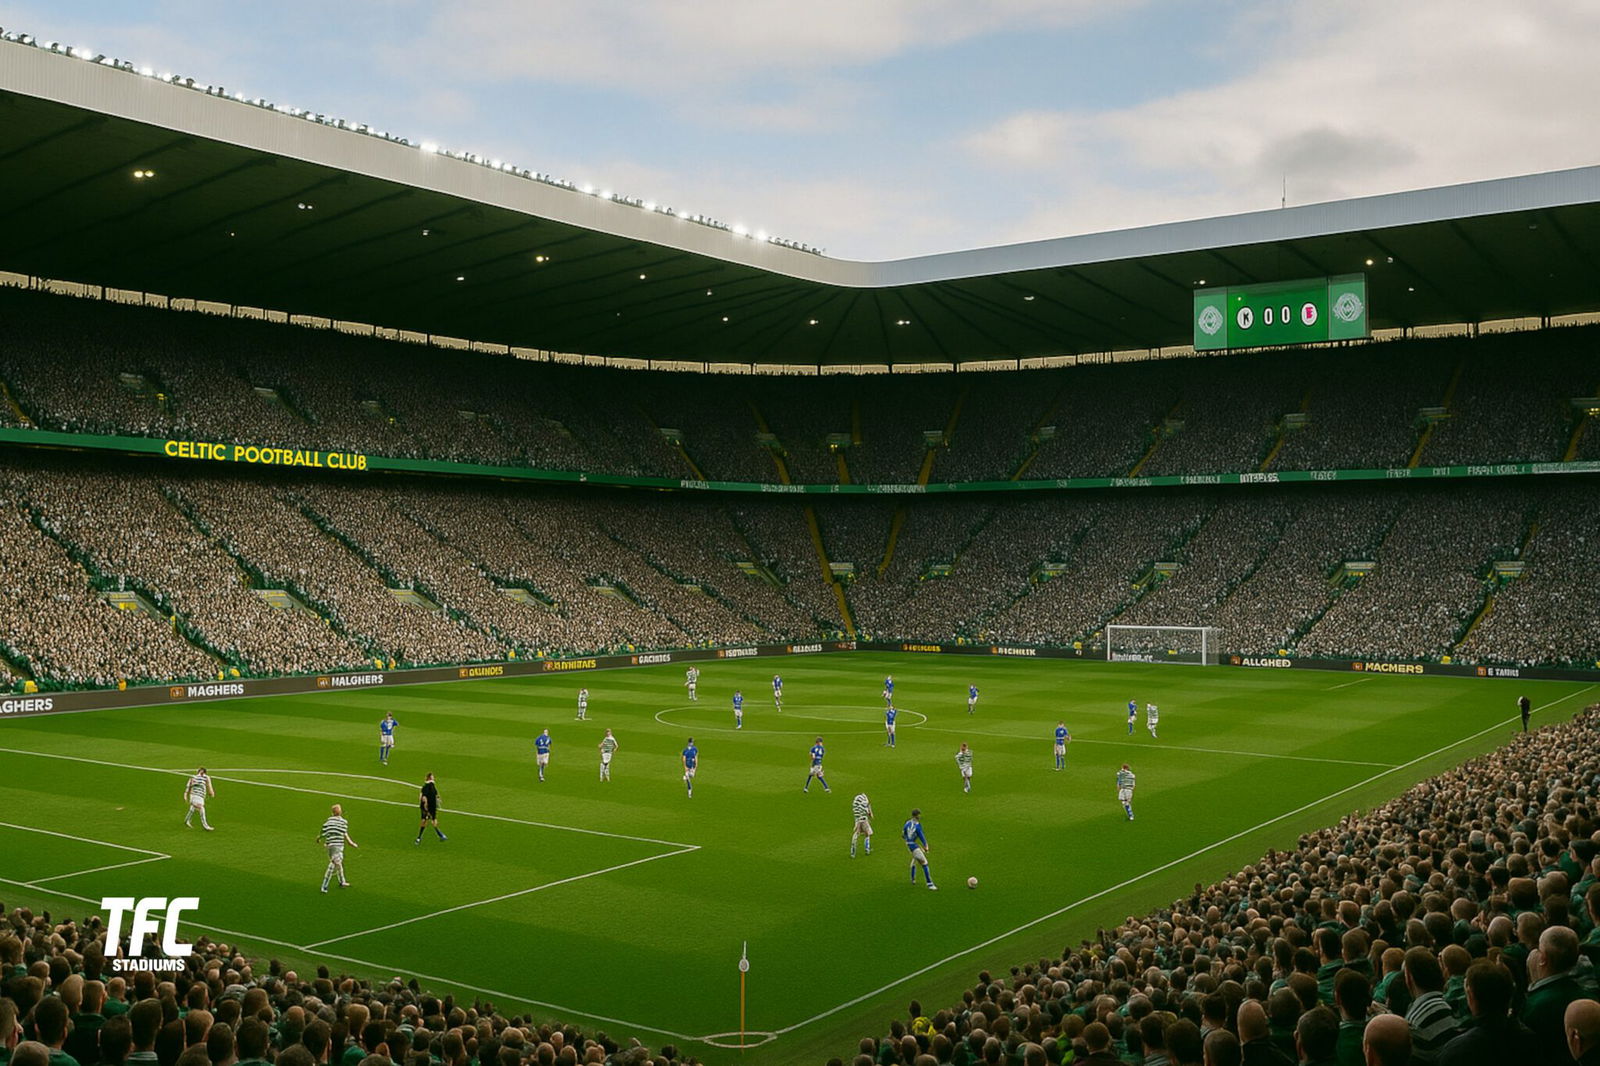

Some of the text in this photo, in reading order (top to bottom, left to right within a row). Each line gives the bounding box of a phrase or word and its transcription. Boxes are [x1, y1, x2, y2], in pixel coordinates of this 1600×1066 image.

[164, 439, 226, 461] CELTIC
[327, 452, 367, 471] CLUB
[1365, 662, 1424, 673] MACMERS
[187, 684, 244, 697] MAGHERS
